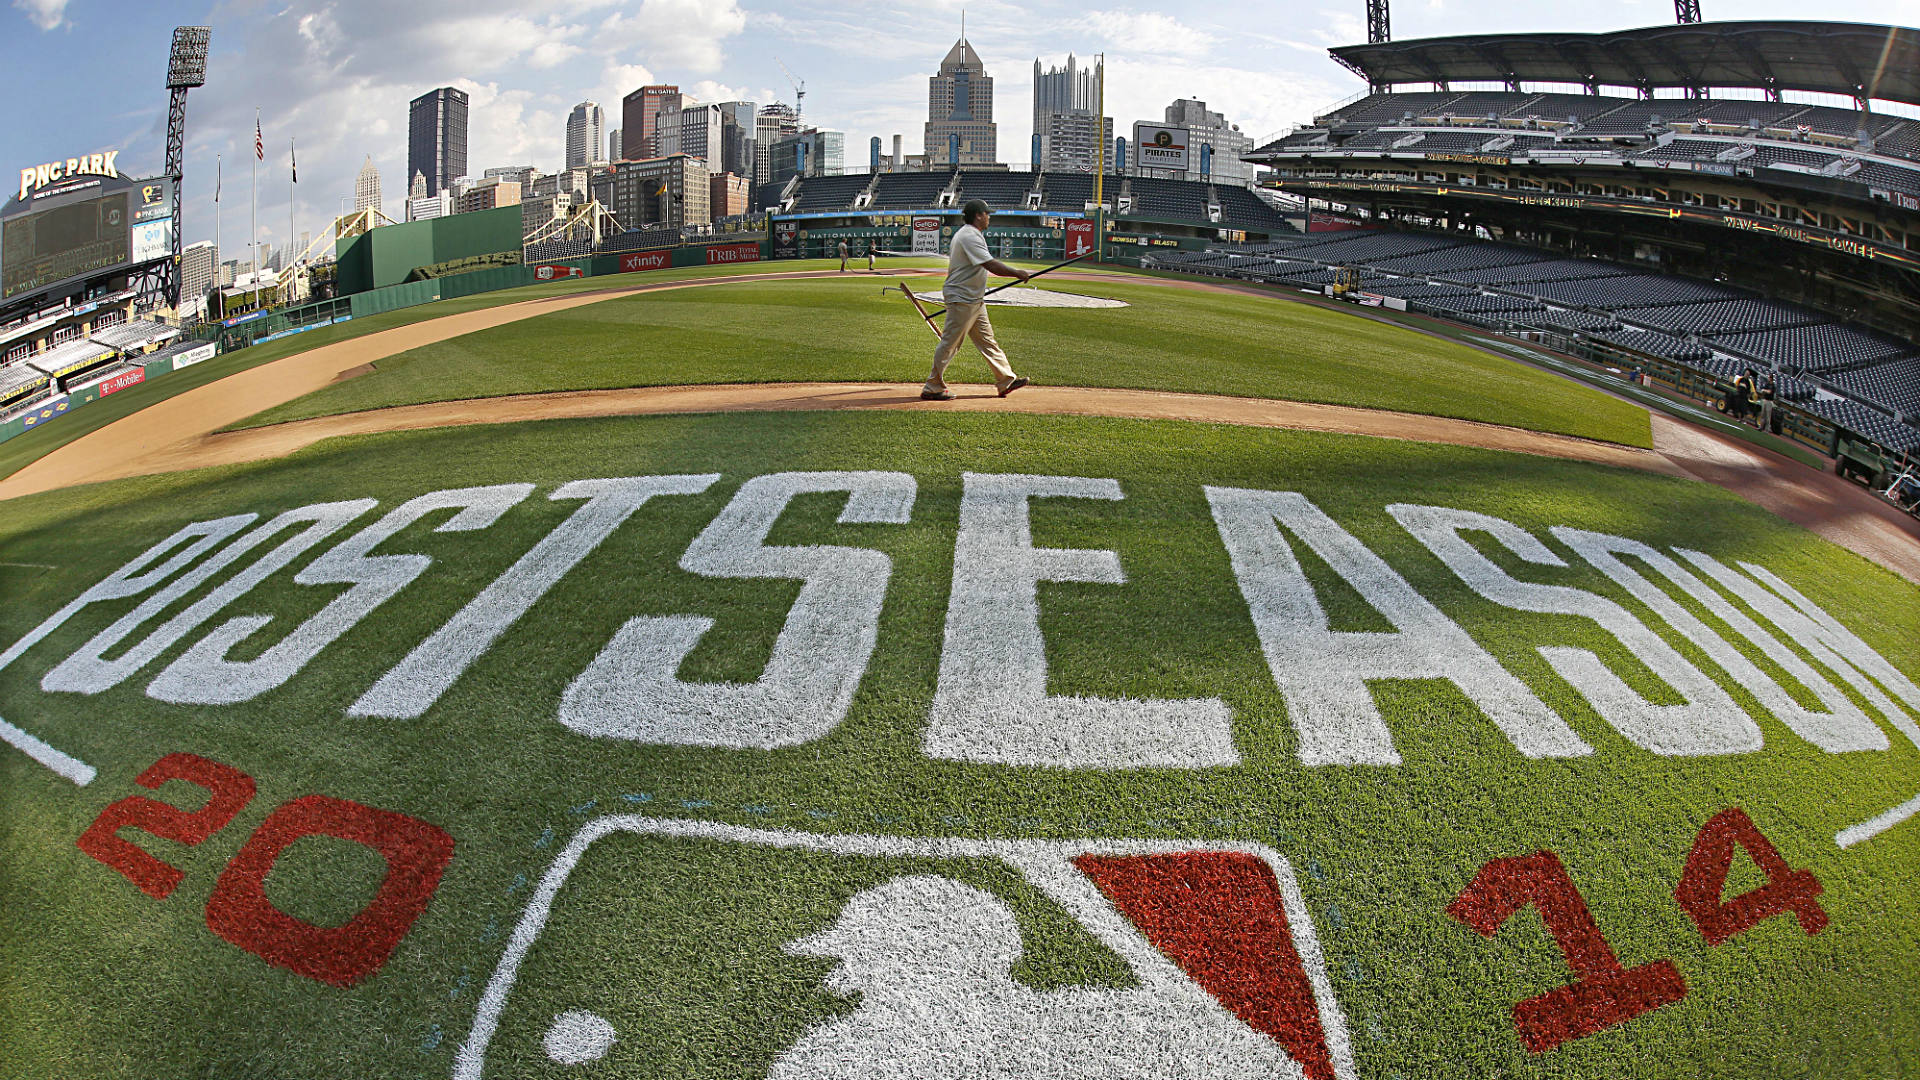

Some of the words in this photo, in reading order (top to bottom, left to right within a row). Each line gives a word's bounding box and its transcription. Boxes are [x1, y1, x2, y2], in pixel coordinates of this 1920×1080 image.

[1145, 149, 1181, 158] PIRATES
[1701, 164, 1714, 172] PNC
[1714, 165, 1733, 173] BANK
[19, 162, 62, 201] PNC
[65, 151, 119, 179] PARK
[776, 223, 796, 231] MLB
[1724, 215, 1759, 232] WAVE
[1772, 224, 1810, 244] YOUR
[809, 231, 858, 240] NATIONAL
[861, 230, 899, 238] LEAGUE
[1011, 231, 1051, 239] LEAGUE
[1111, 236, 1138, 244] BOWSER
[706, 249, 737, 262] TRIB
[626, 254, 665, 269] xfinity
[0, 471, 1920, 770] POSTSEASON
